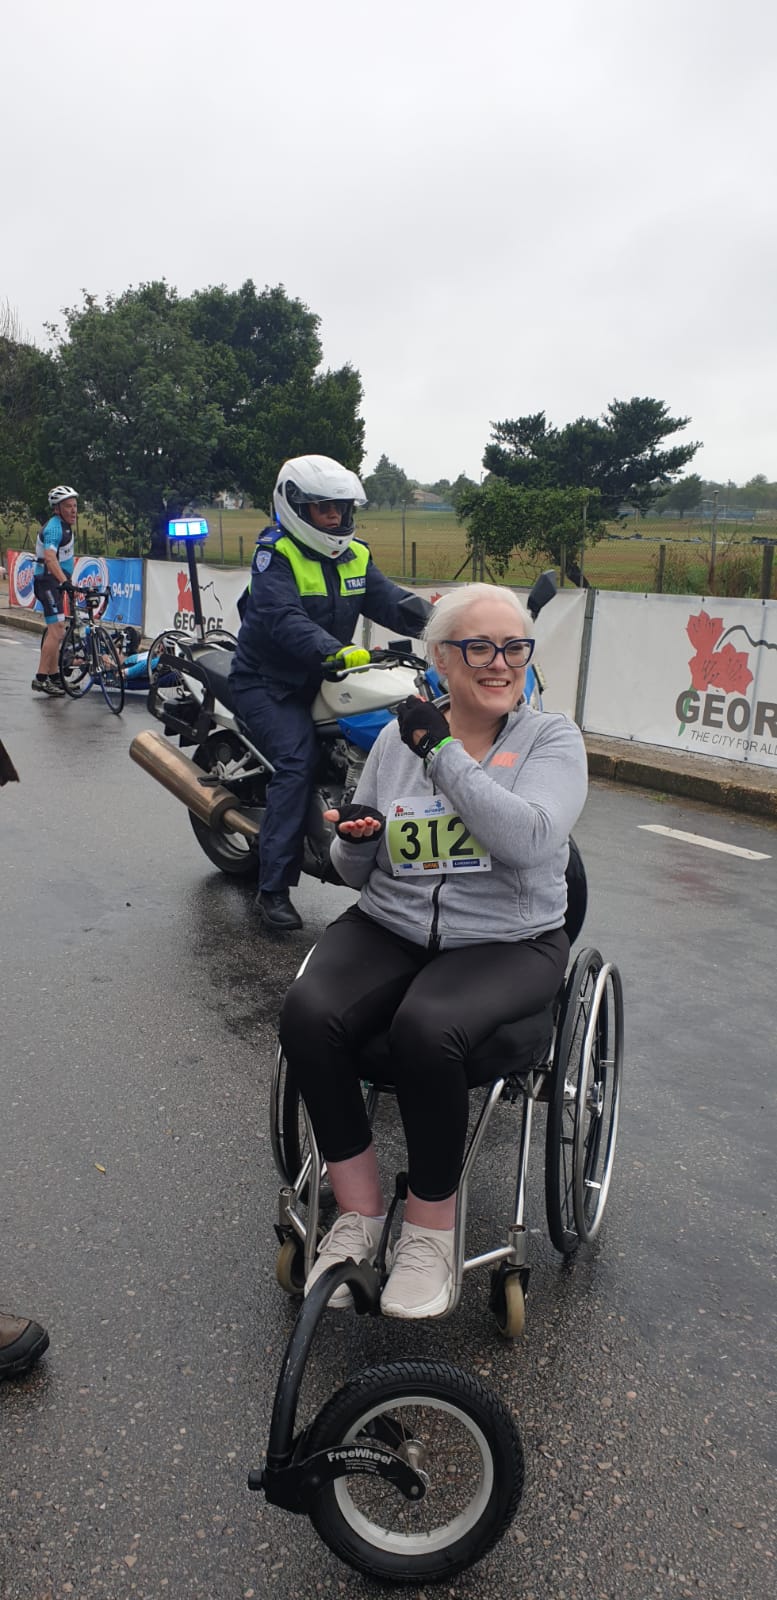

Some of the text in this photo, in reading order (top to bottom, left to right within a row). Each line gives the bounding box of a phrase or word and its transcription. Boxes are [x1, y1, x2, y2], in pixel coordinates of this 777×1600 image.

[112, 582, 135, 599] 94-97
[691, 730, 710, 743] THE
[711, 734, 735, 748] CITY
[736, 738, 758, 752] FOR
[400, 816, 474, 860] 312
[327, 1448, 393, 1465] FreeWheel
